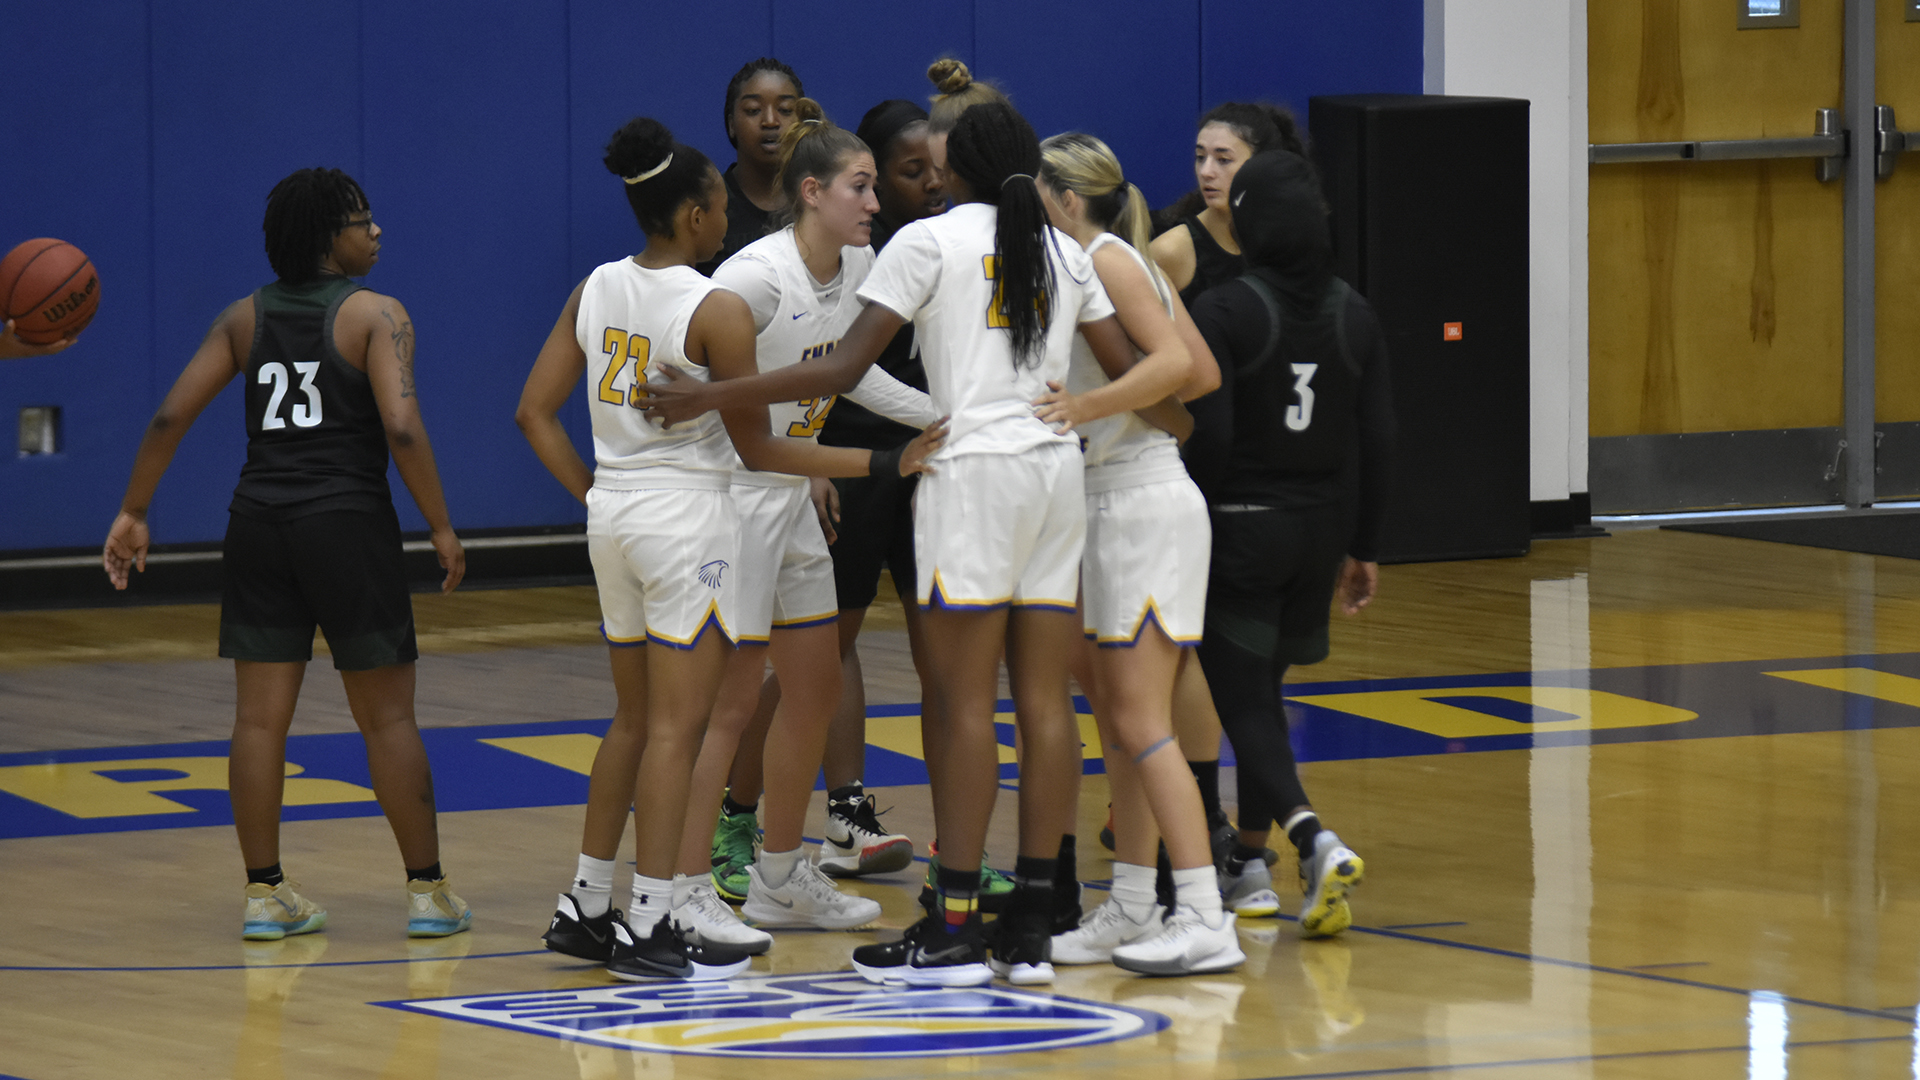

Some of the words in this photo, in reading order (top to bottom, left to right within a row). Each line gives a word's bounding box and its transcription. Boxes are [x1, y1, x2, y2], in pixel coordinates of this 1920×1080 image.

[42, 273, 97, 323] Wilson
[1446, 326, 1460, 336] JBL
[257, 361, 323, 431] 23
[597, 326, 651, 411] 23
[1284, 362, 1318, 432] 3
